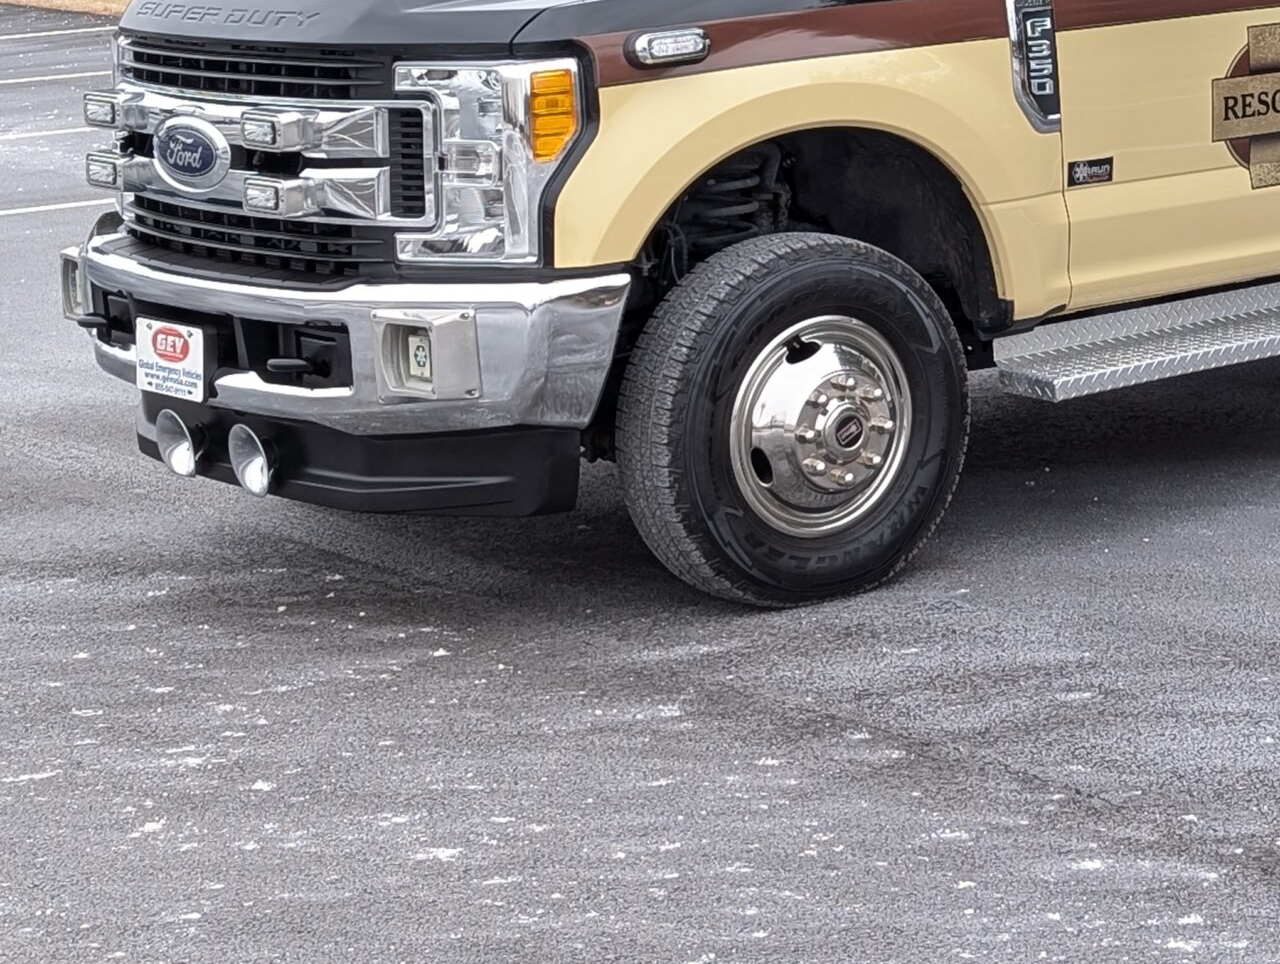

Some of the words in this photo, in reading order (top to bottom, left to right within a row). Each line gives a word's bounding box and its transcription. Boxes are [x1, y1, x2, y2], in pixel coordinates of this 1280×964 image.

[135, 1, 223, 23] SUPER
[223, 8, 321, 28] DUTY
[1025, 17, 1054, 96] F350
[166, 134, 203, 168] Ford
[156, 333, 184, 354] GEV
